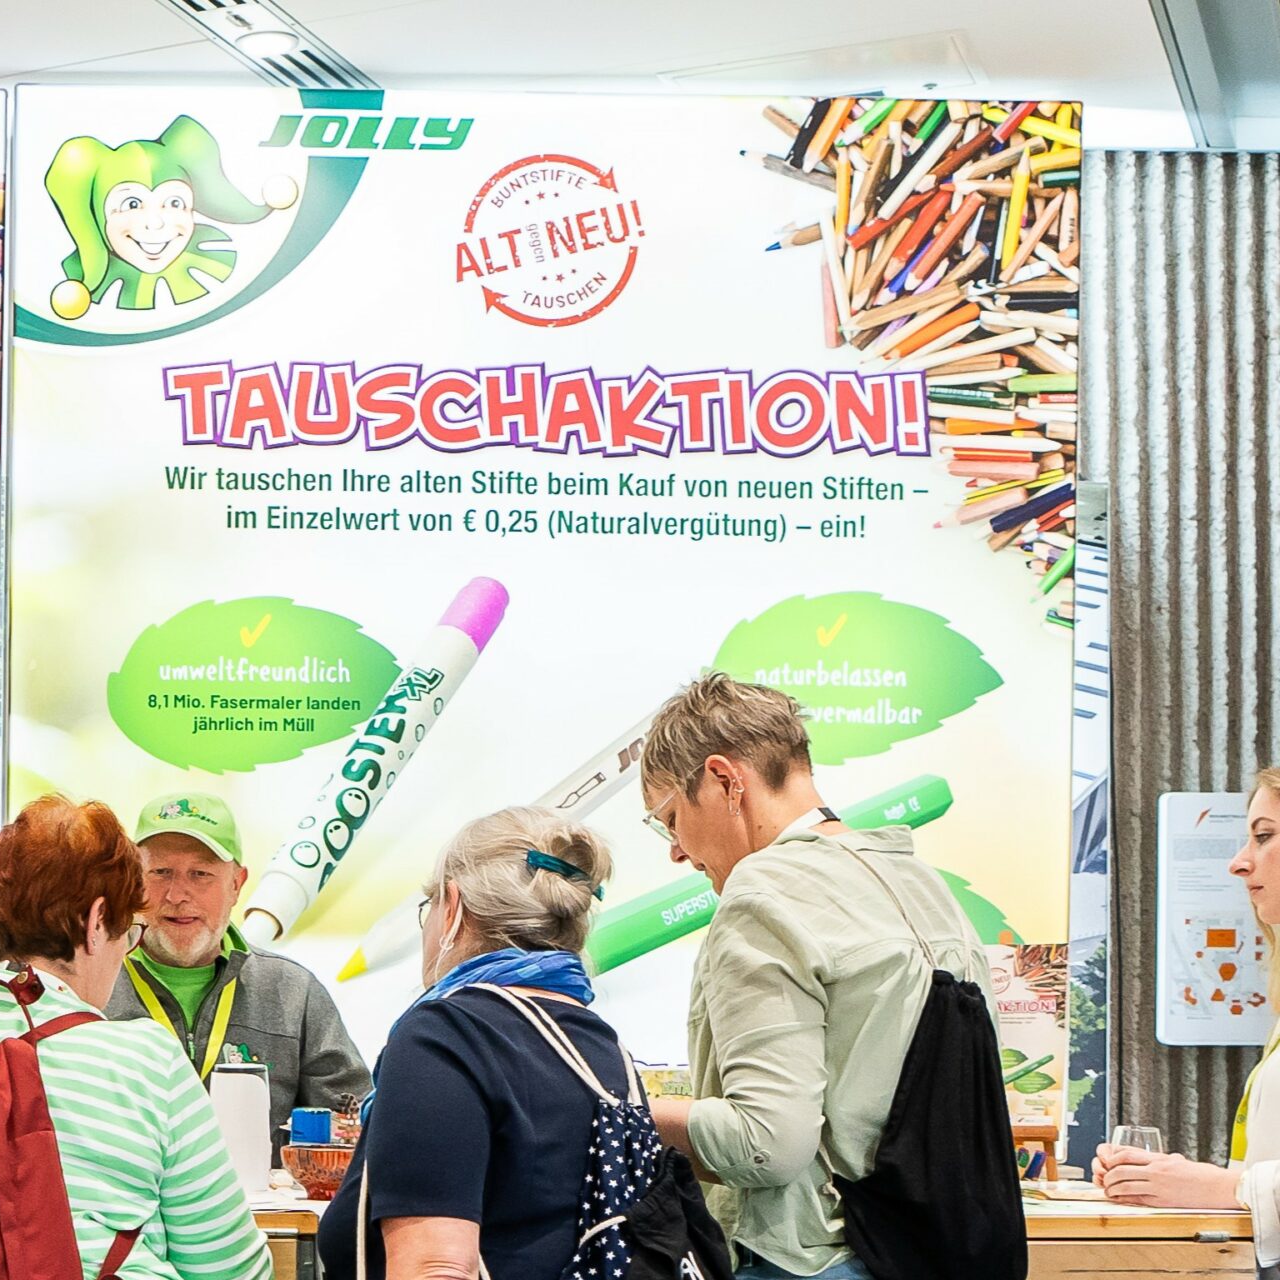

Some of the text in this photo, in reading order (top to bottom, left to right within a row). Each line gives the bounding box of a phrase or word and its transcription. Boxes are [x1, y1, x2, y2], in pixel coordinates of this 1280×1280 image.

[258, 115, 474, 150] JOLLY
[491, 169, 587, 209] BUNTSTIFTE
[456, 228, 522, 283] ALT
[545, 200, 646, 259] NEU!
[522, 272, 607, 309] TAUSCHEN
[163, 361, 932, 458] TAUSCHAKTION!
[165, 467, 207, 489] Wir
[216, 468, 331, 491] tauschen
[343, 469, 390, 492] Ihre
[401, 470, 461, 493] alten
[472, 471, 537, 494] Stifte
[549, 472, 608, 495] beim
[620, 473, 675, 496] Kauf
[685, 480, 726, 497] von
[739, 481, 812, 498] neuen
[823, 477, 903, 500] Stiften
[228, 505, 256, 528] im
[268, 506, 399, 530] Einzelwert
[409, 514, 451, 531] von
[464, 509, 476, 532] €
[486, 510, 537, 536] 0,25
[549, 511, 786, 542] (Naturalvergütung)
[821, 515, 865, 537] ein!
[159, 656, 351, 684] umweltfreundlich
[754, 659, 907, 688] naturbelassen
[148, 694, 361, 711] 8,1 Mio. Fasermaler landen
[800, 697, 923, 725] vermalbar
[192, 716, 315, 735] jährlich im Müll
